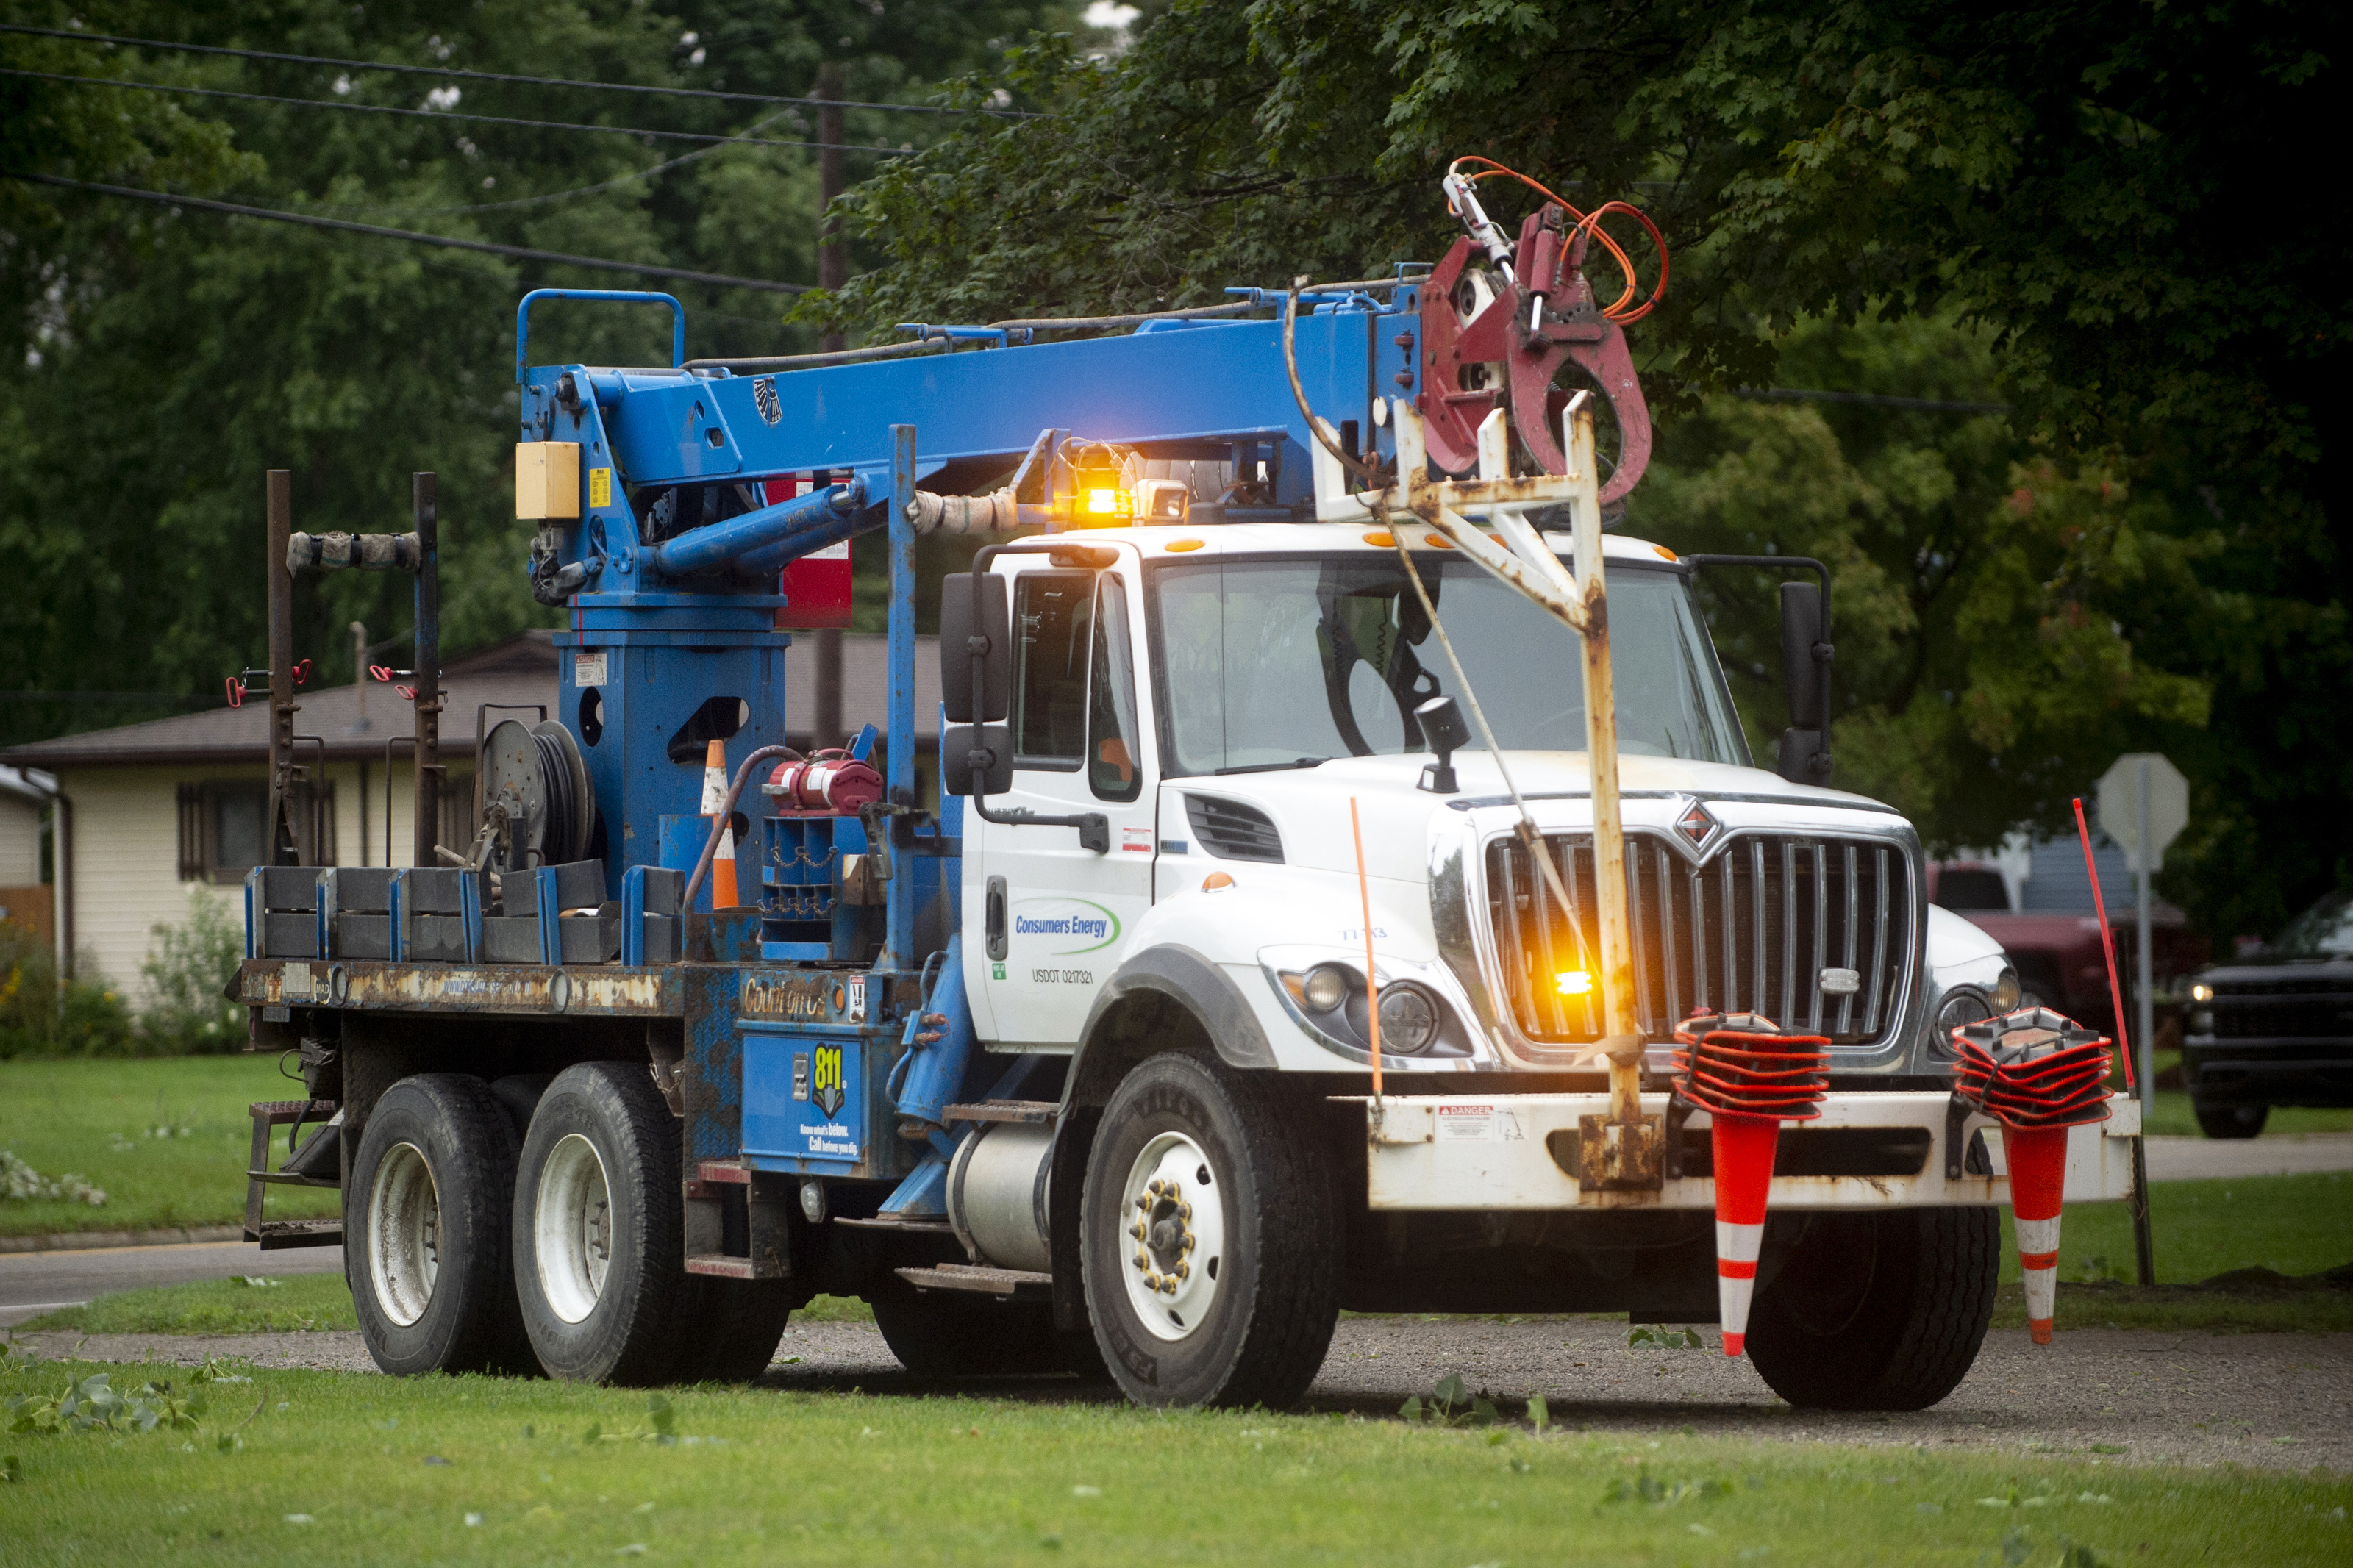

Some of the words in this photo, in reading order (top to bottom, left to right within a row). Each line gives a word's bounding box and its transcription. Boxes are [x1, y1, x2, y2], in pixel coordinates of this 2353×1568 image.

[1016, 915, 1070, 934] Consumers
[1072, 916, 1107, 937] Energy
[1032, 969, 1059, 983] USDOT
[1063, 970, 1093, 984] 0217321
[815, 1046, 840, 1090] 811
[1451, 1106, 1492, 1114] DANGER
[800, 1123, 813, 1134] Know
[814, 1125, 828, 1135] what's
[828, 1122, 849, 1136] below.
[809, 1136, 822, 1151] Call
[822, 1140, 838, 1153] before
[839, 1143, 848, 1155] you
[849, 1142, 858, 1156] dig.
